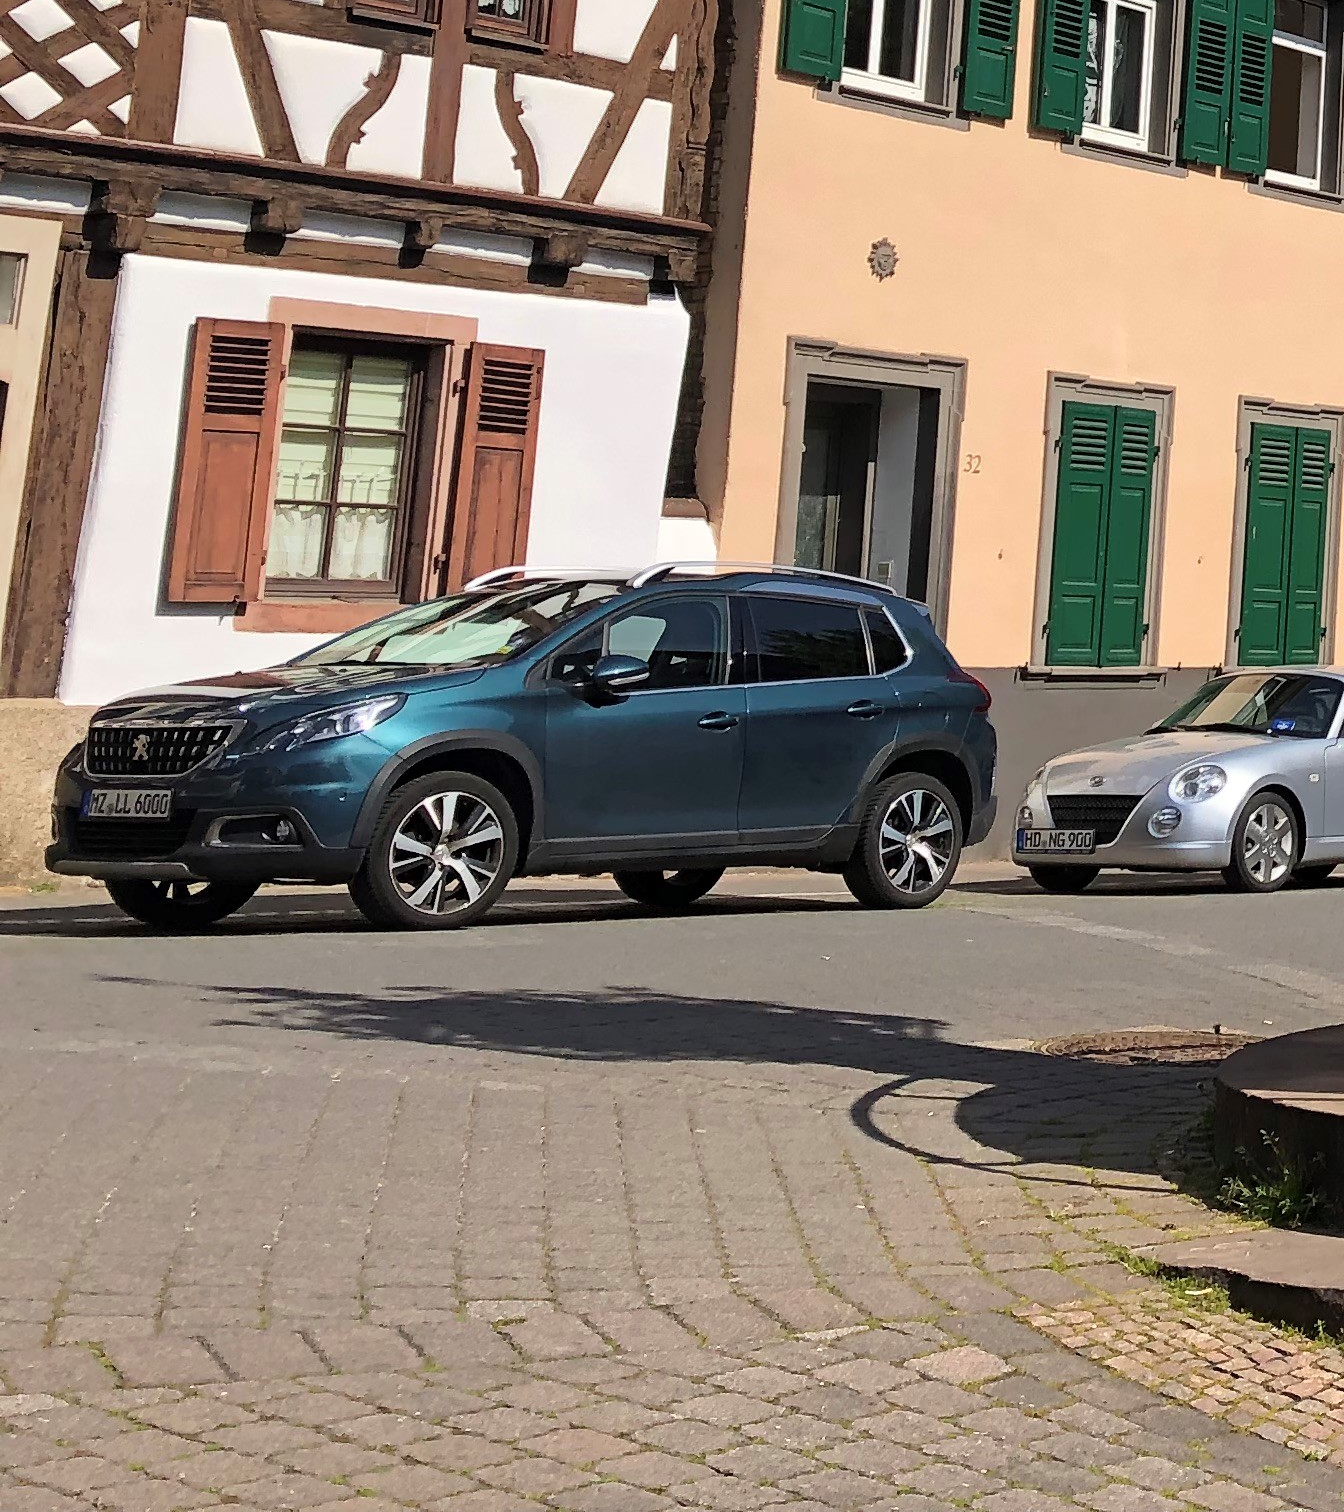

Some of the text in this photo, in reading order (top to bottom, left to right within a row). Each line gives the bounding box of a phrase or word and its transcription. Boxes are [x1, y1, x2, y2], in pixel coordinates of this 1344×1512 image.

[963, 453, 981, 474] 32
[135, 793, 169, 815] 6000
[1025, 831, 1091, 848] HD NG 900
